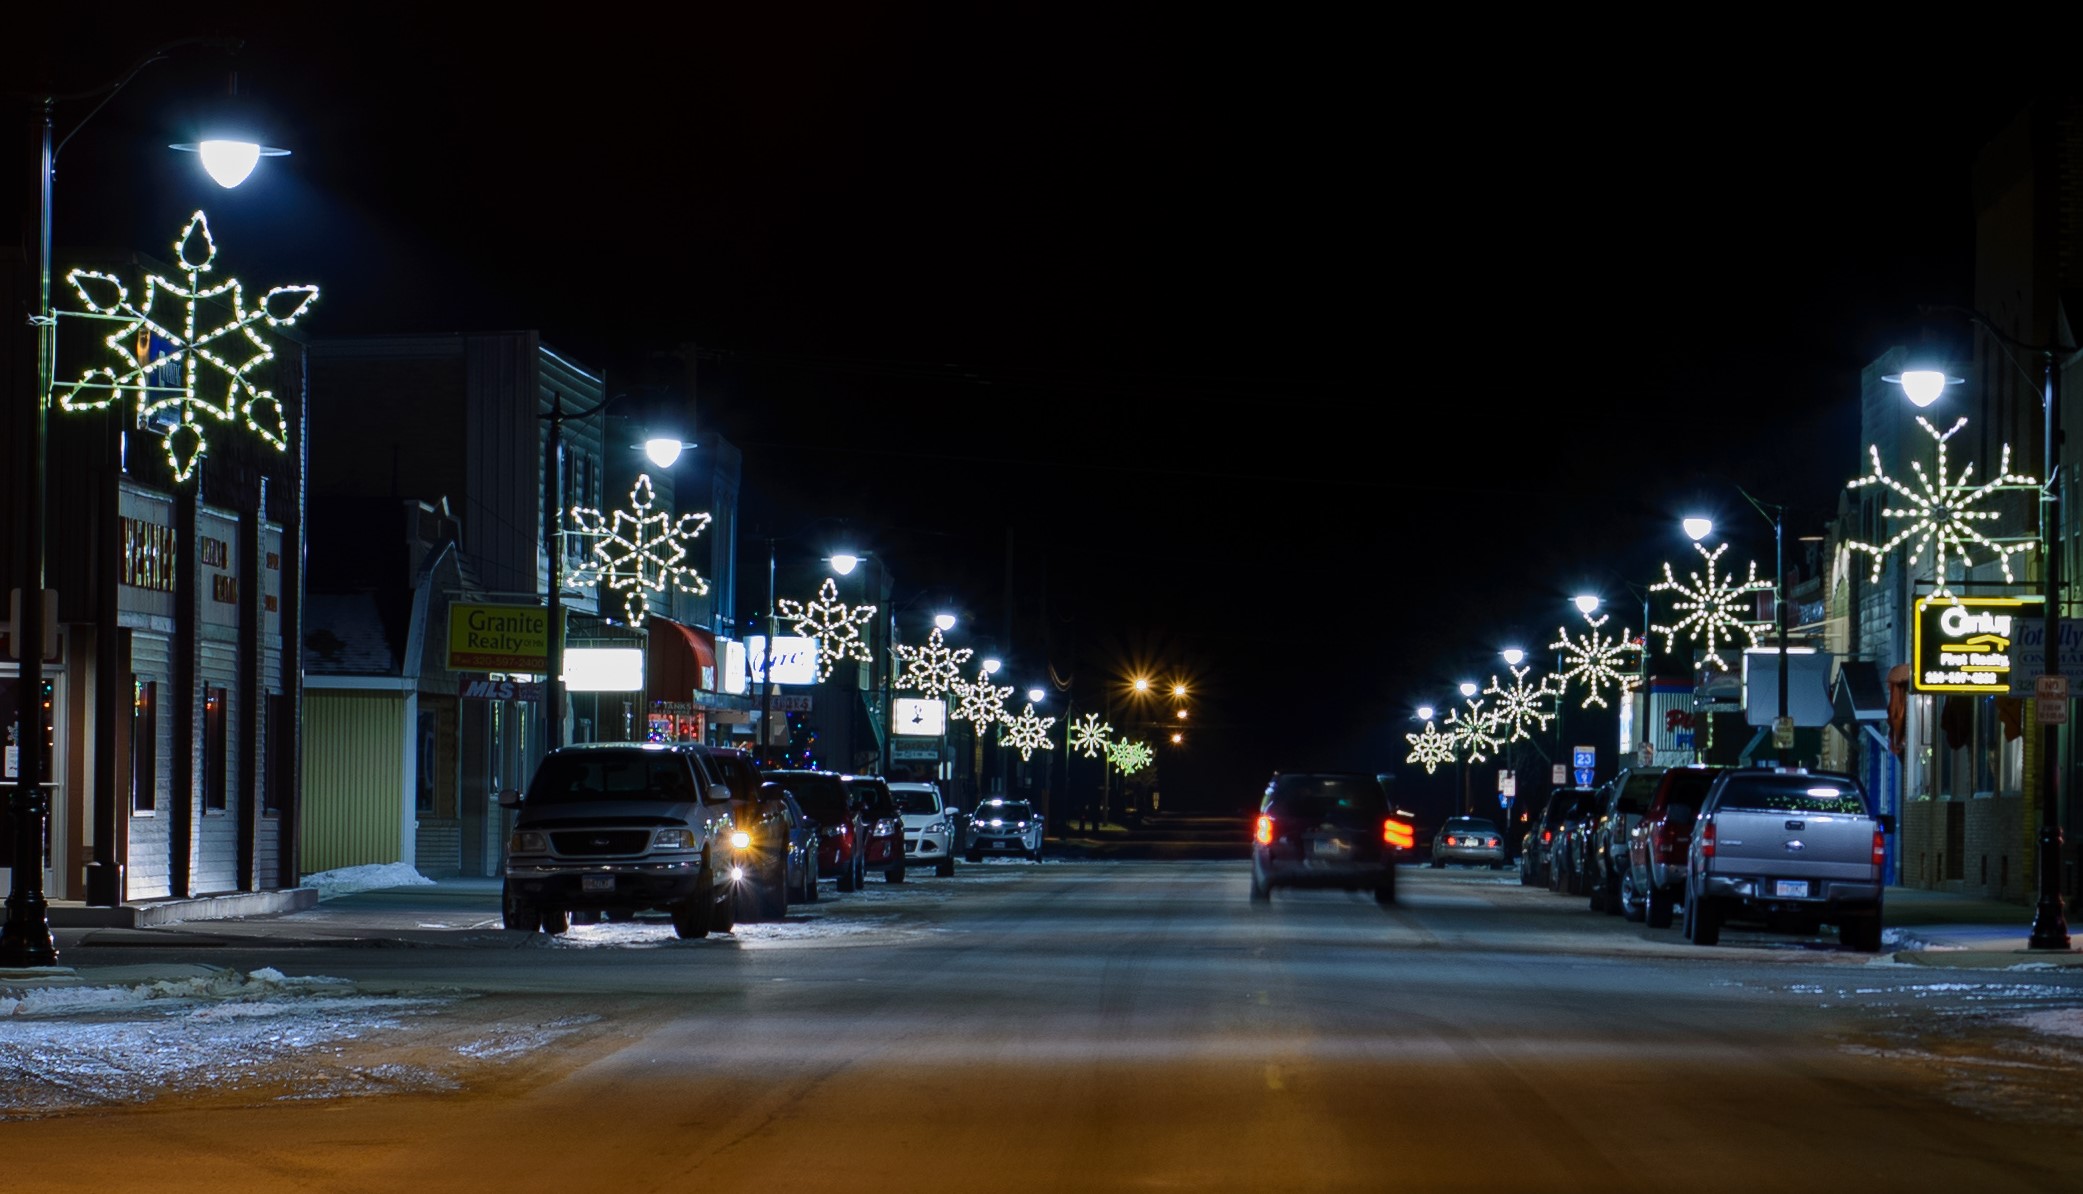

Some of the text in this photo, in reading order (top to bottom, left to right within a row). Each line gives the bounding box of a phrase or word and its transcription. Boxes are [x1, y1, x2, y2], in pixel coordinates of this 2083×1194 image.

[467, 609, 544, 634] Granite
[467, 631, 523, 653] Realty
[2015, 622, 2083, 652] Totlly
[473, 655, 545, 668] 320-597-2400
[465, 681, 515, 699] MLS
[2044, 681, 2060, 691] NO
[1577, 754, 1592, 765] 23
